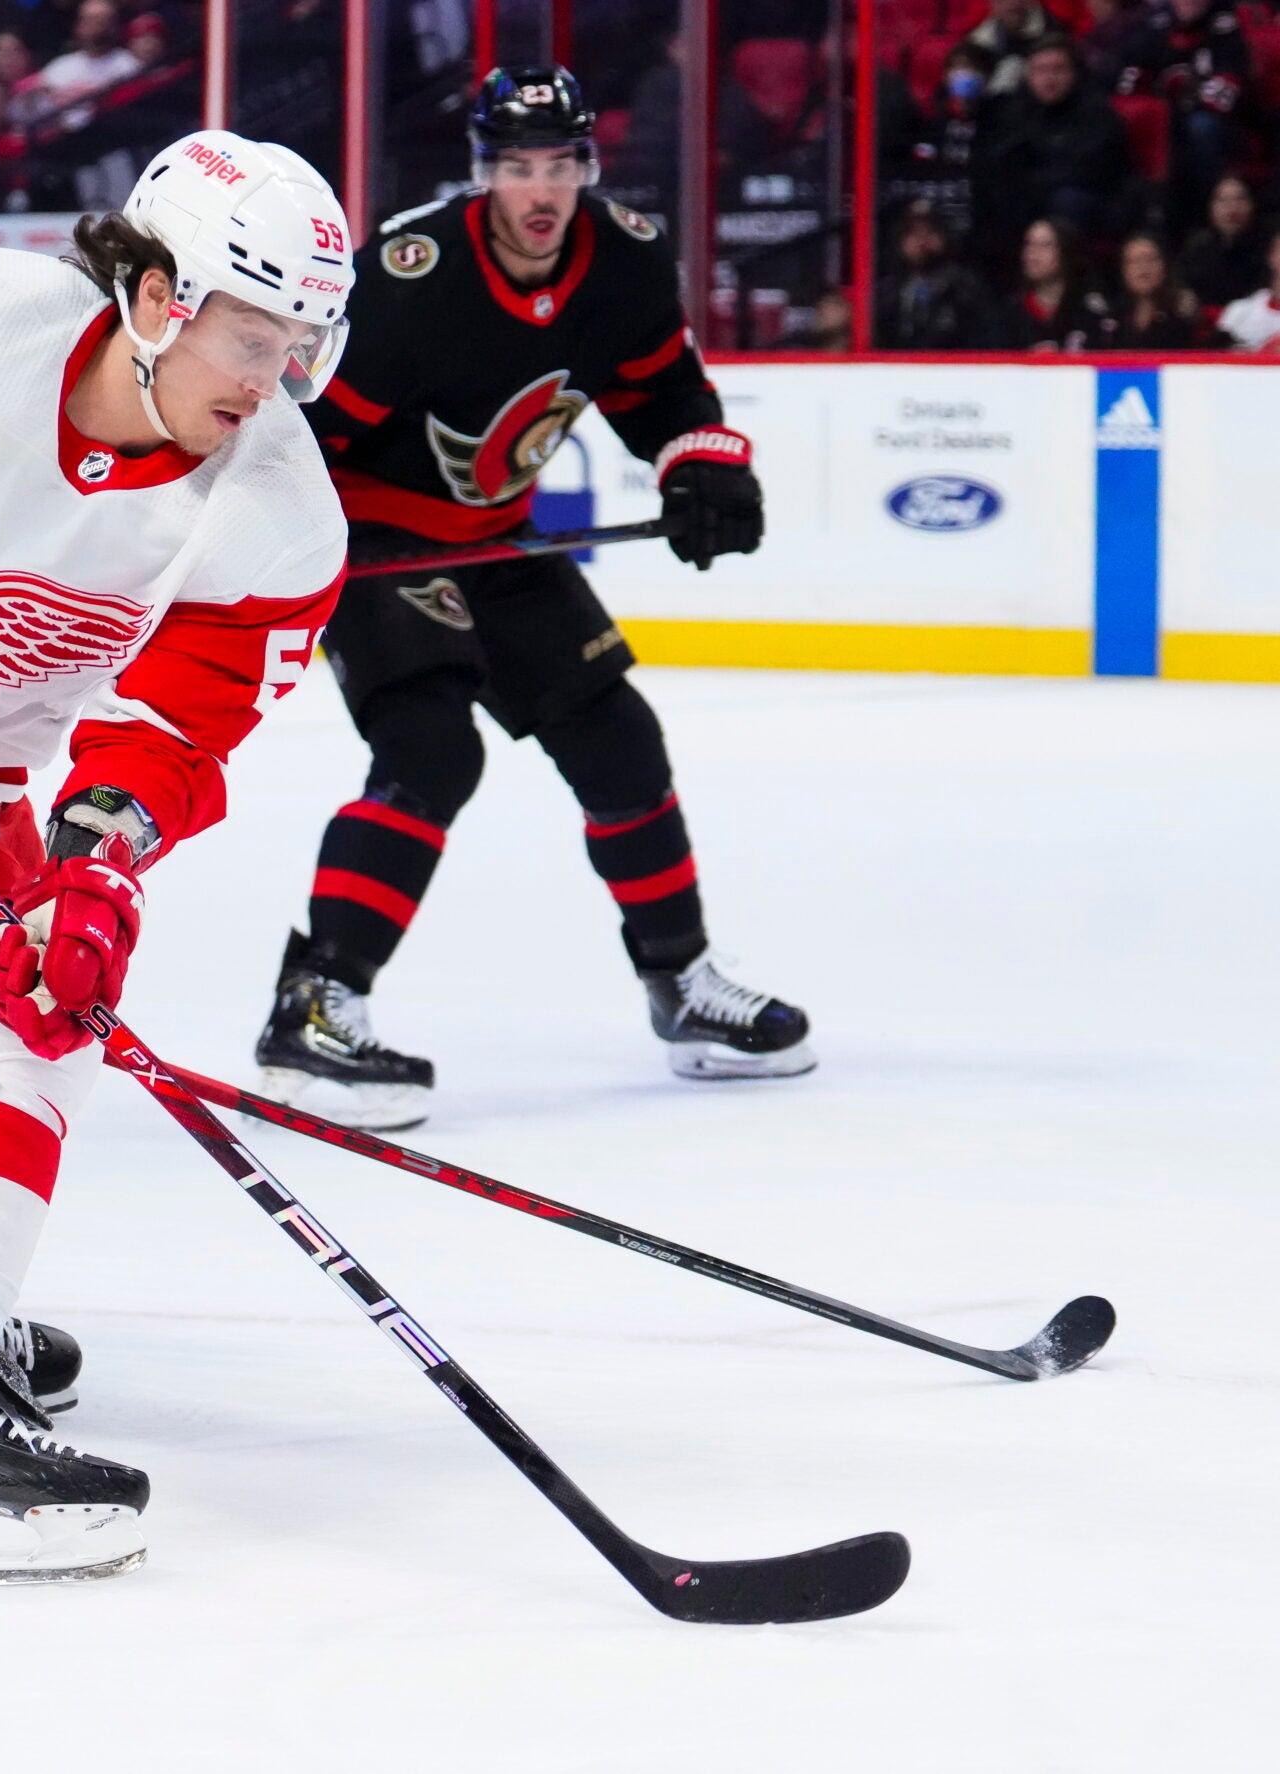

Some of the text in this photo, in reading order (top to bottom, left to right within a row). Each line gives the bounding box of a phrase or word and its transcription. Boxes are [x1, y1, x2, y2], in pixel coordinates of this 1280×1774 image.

[181, 142, 246, 185] meijer
[311, 217, 345, 253] 59
[300, 276, 345, 295] CCM
[170, 304, 190, 318] CCM
[251, 624, 327, 716] 5
[120, 1046, 175, 1088] PX
[231, 1142, 450, 1373] TRUE
